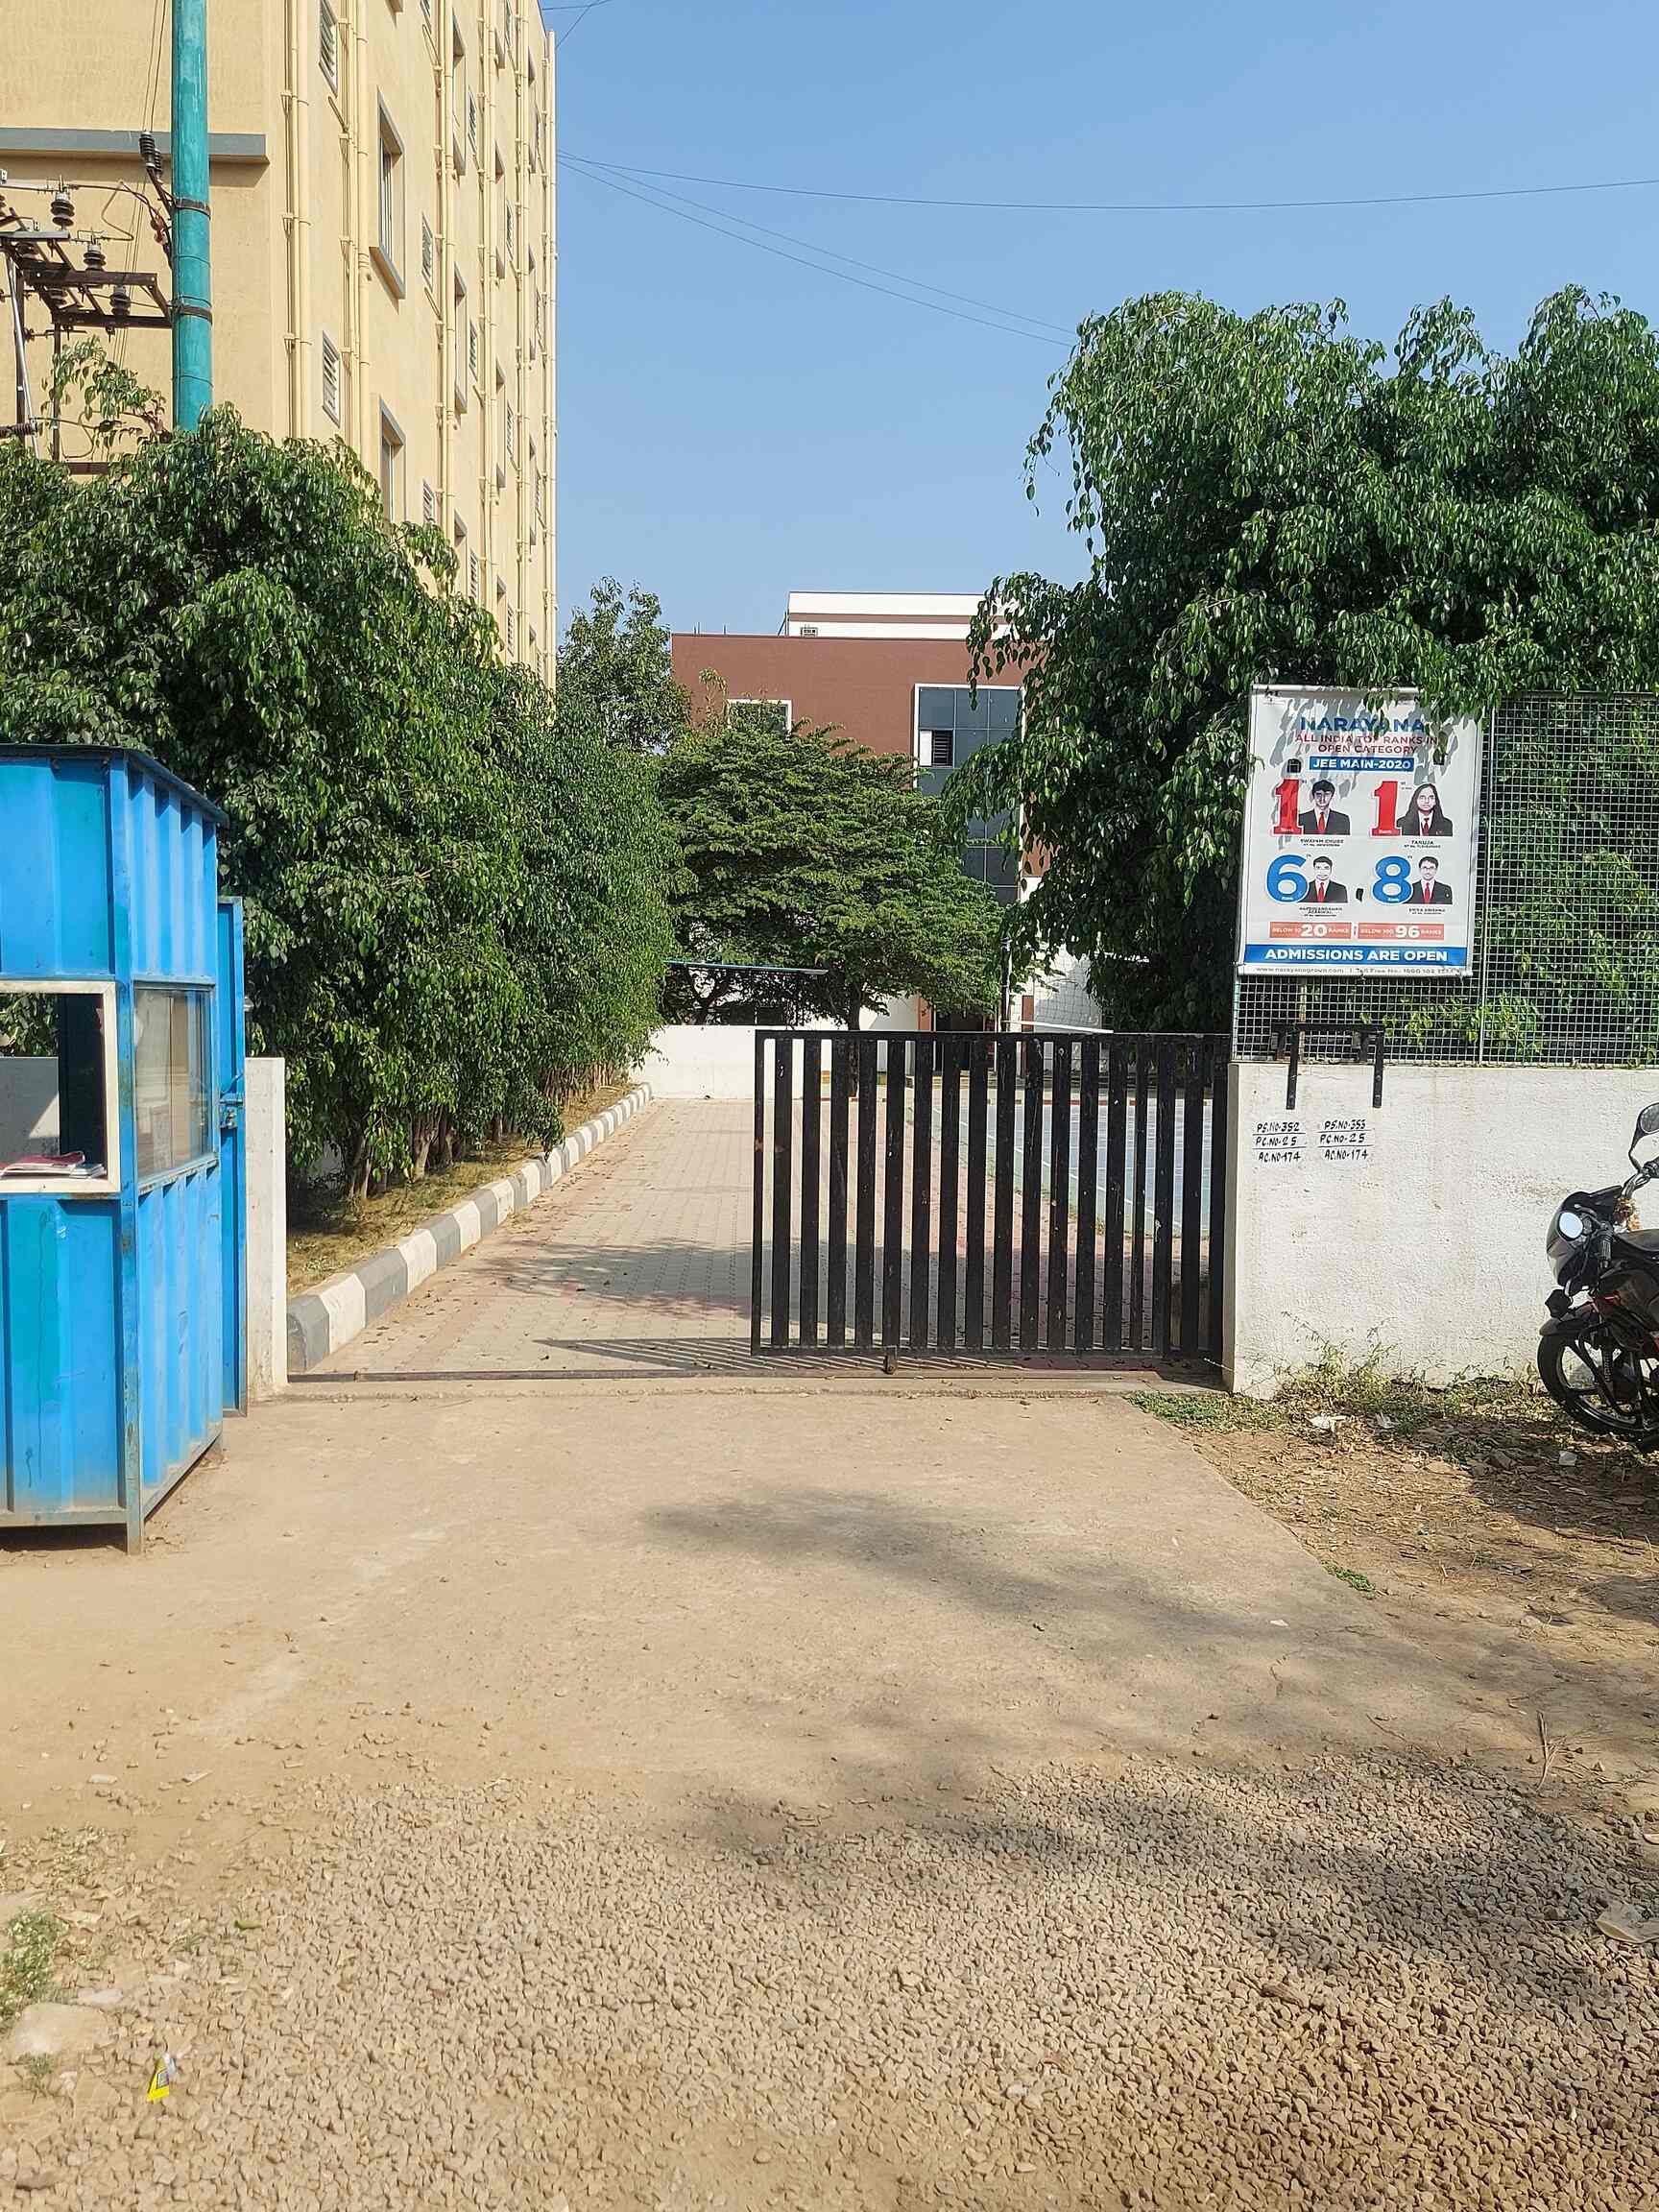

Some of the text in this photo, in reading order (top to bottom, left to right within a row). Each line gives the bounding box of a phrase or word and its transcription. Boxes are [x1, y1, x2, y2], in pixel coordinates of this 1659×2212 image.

[1296, 733, 1316, 742] ALL
[1321, 734, 1352, 743] INDIA
[1427, 736, 1437, 745] IN
[1355, 745, 1417, 754] CATEGORY
[1312, 758, 1411, 769] JEE MAIN-2020
[1274, 779, 1303, 834] 1
[1372, 781, 1401, 836] 1
[1266, 854, 1310, 902] 6
[1372, 855, 1413, 903] 8
[1300, 924, 1328, 937] 20
[1395, 925, 1420, 938] 96
[1264, 949, 1448, 961] ADMISSIONS ARE OPEN
